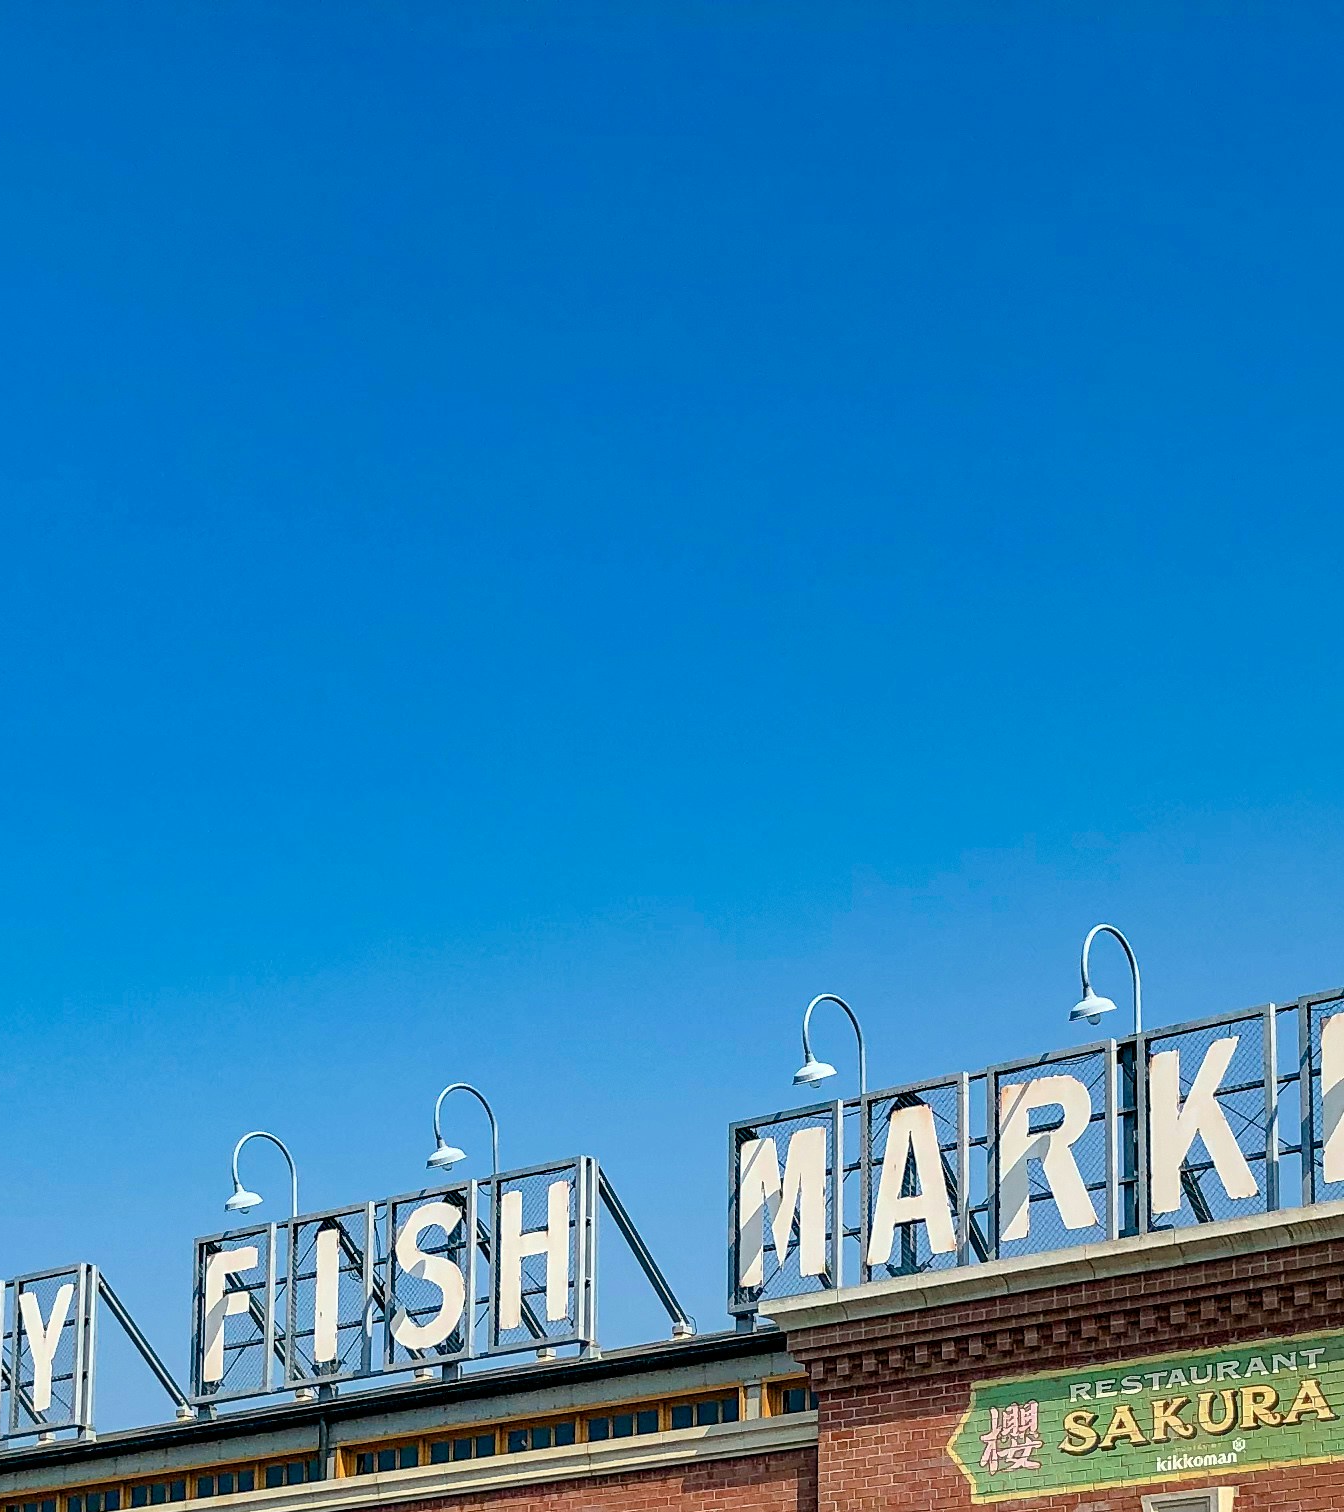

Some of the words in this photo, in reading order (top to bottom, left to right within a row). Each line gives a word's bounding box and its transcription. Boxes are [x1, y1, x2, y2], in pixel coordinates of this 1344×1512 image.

[204, 1180, 570, 1382] FISH
[1069, 1347, 1326, 1402] RESTAURANT
[1059, 1379, 1338, 1455] SAKURA
[1156, 1451, 1238, 1472] kikkoman
